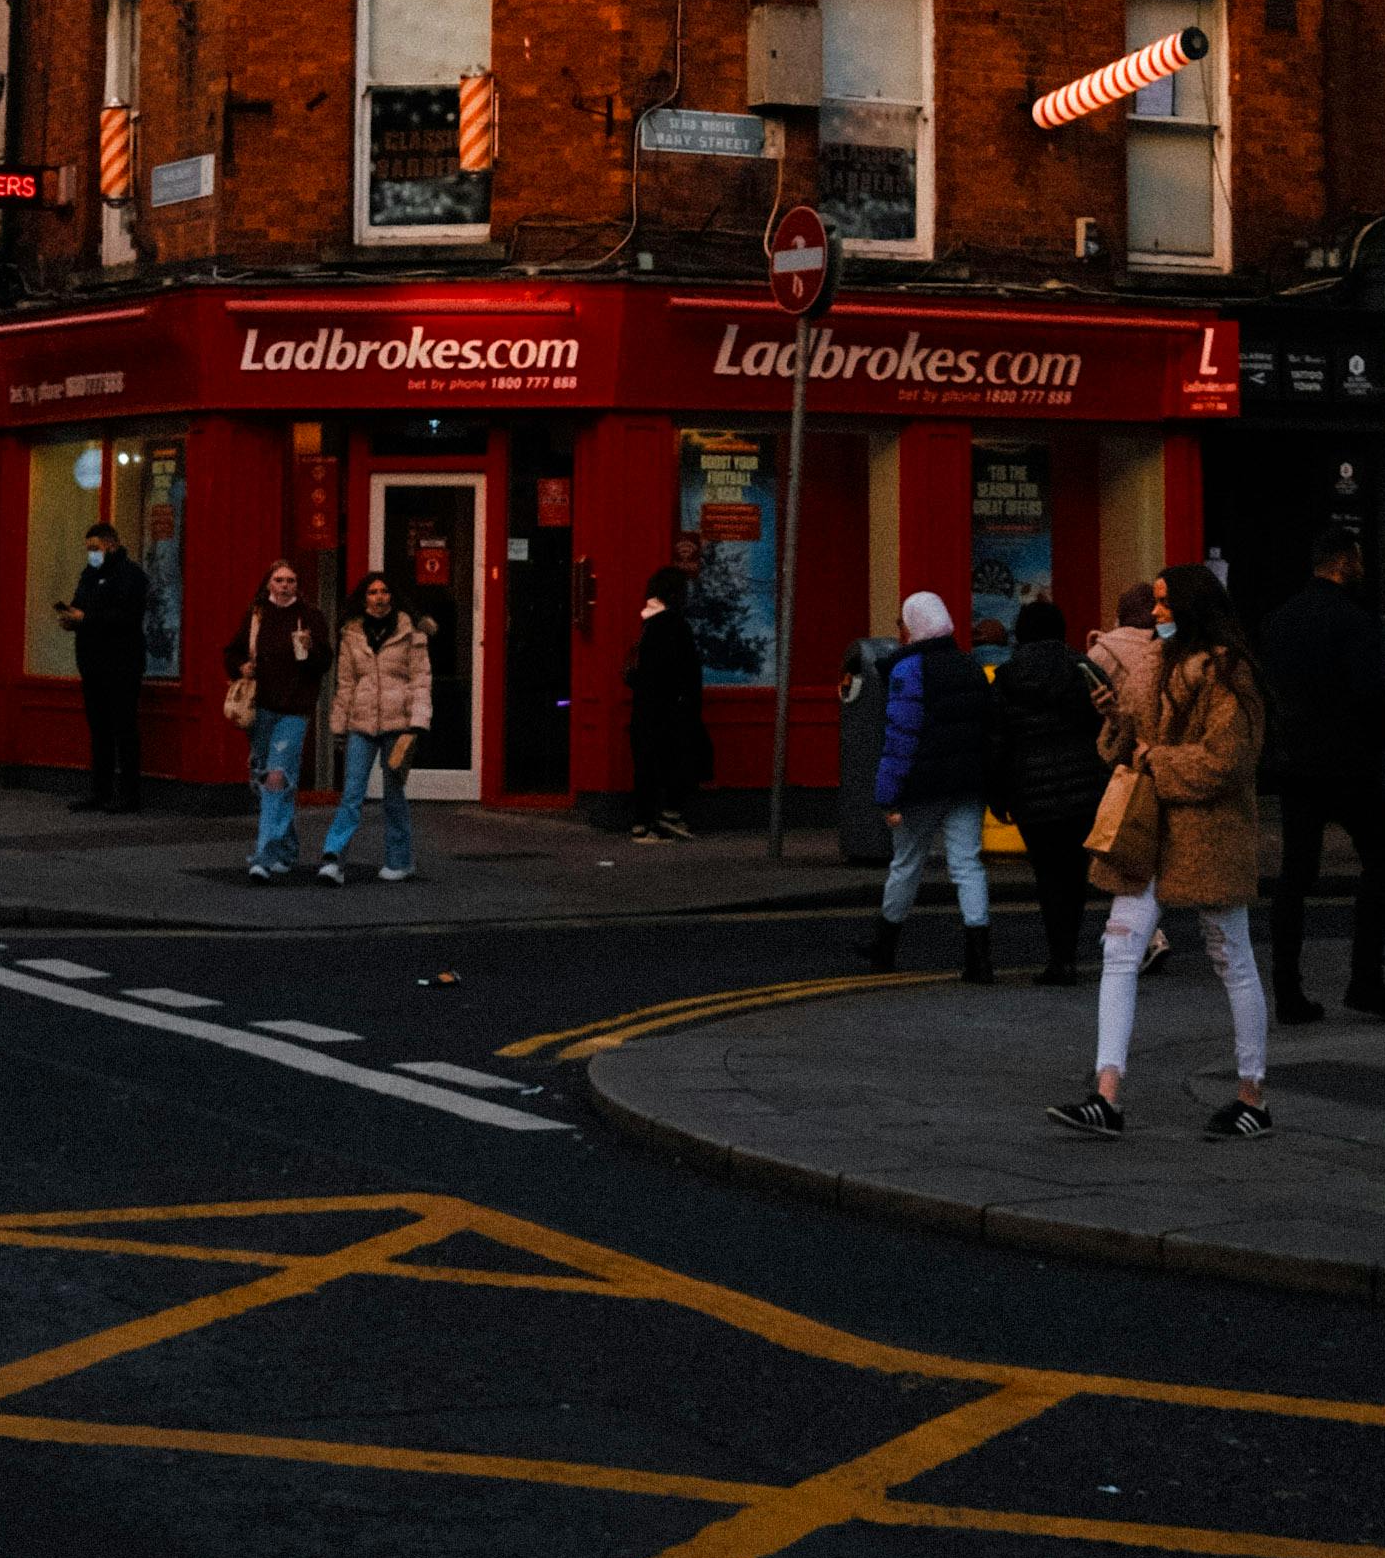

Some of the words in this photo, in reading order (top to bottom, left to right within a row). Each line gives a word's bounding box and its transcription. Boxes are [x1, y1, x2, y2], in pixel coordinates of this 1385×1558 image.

[699, 136, 752, 151] STREET
[239, 326, 580, 371] Ladbrokes.com
[713, 323, 1082, 387] Ladbrokes.com
[1199, 327, 1219, 375] L
[407, 378, 427, 391] bet
[431, 378, 445, 392] by
[448, 377, 487, 392] phone
[490, 376, 522, 390] 1800
[526, 376, 550, 390] 777
[898, 388, 920, 402] bet
[923, 390, 938, 405] by
[941, 389, 980, 405] phone
[985, 389, 1016, 404] 1800
[1020, 390, 1044, 404] 777
